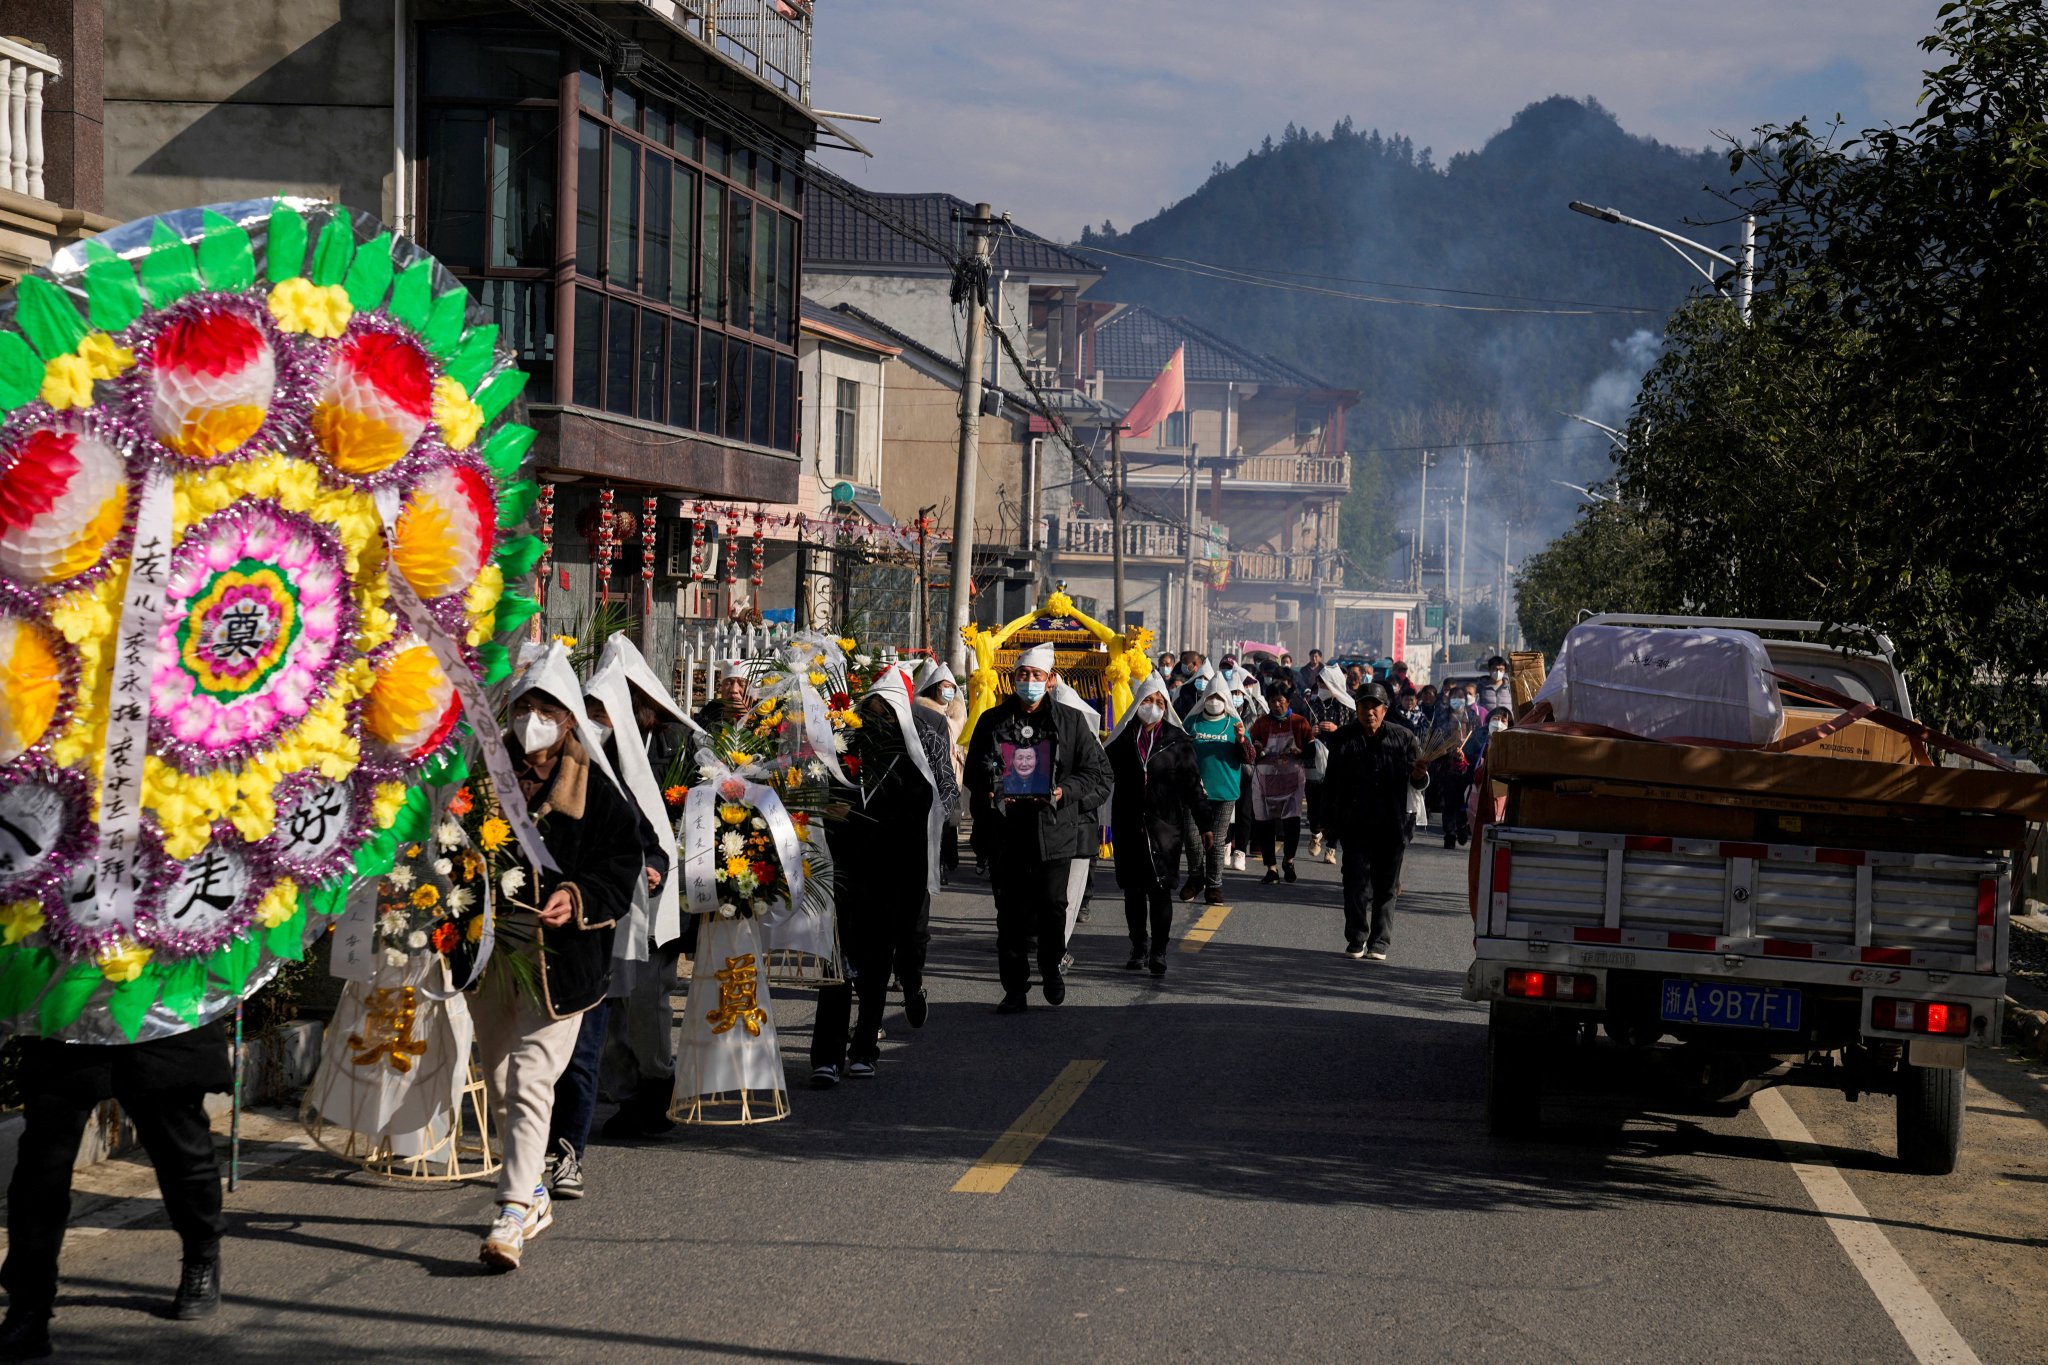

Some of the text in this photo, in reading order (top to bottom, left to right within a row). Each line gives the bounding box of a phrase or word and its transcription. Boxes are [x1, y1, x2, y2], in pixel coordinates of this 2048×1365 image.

[211, 605, 264, 658] 奠
[347, 986, 428, 1073] 奠
[706, 953, 768, 1037] 奠
